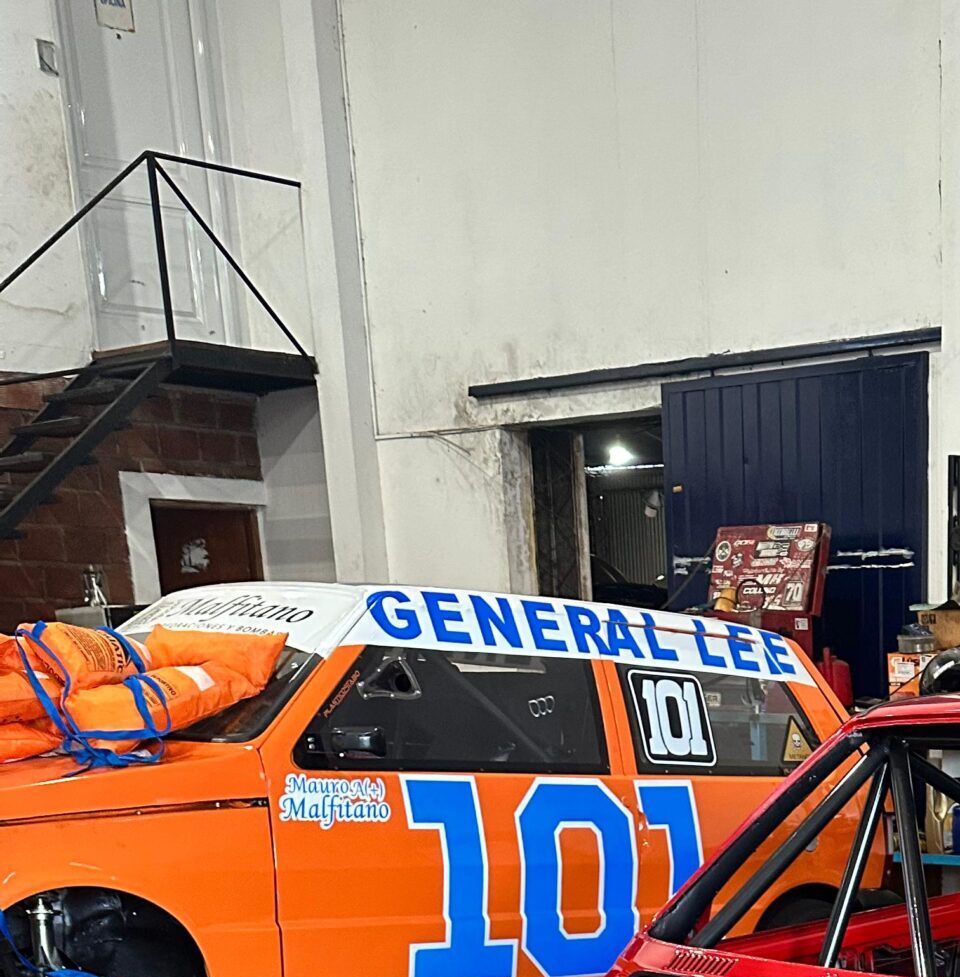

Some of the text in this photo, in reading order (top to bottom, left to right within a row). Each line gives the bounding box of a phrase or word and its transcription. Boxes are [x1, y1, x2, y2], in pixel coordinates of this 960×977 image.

[168, 595, 315, 623] Malfitano
[368, 590, 796, 675] GENERAL LEE
[642, 679, 708, 756] 101
[288, 776, 350, 794] Mauro
[283, 795, 389, 826] Malfitano
